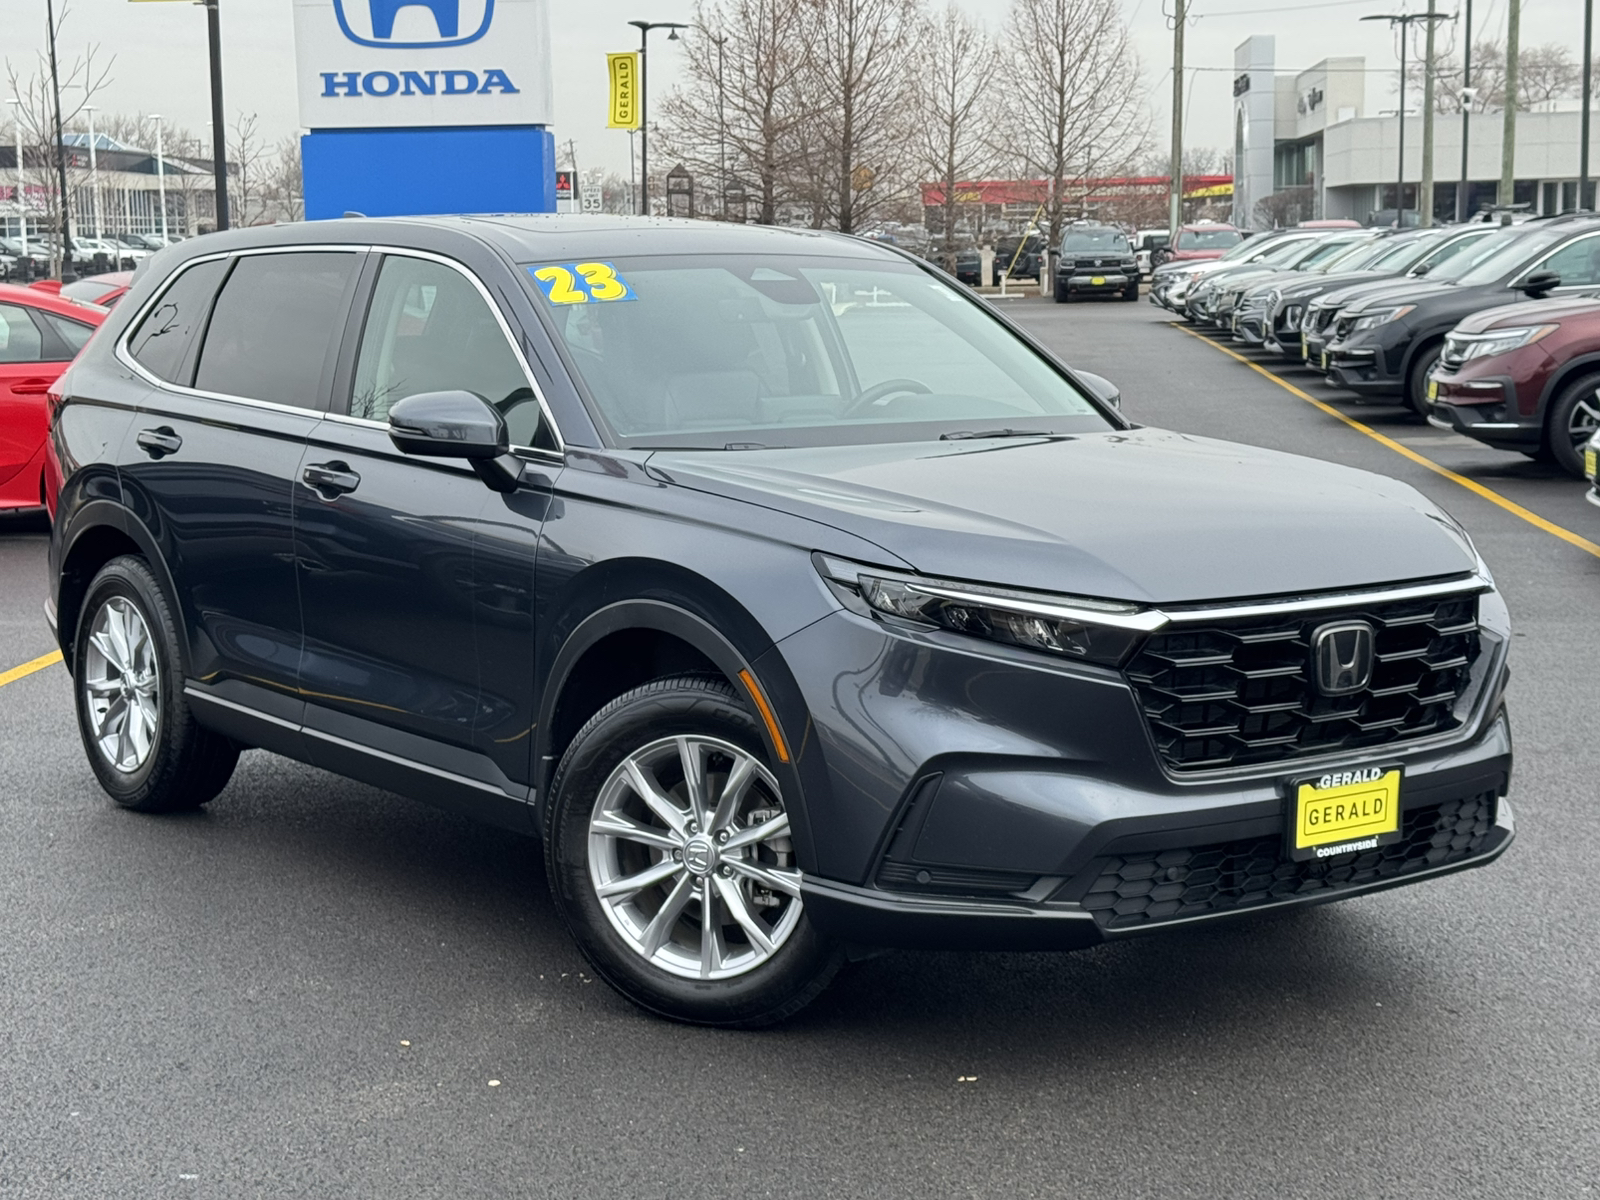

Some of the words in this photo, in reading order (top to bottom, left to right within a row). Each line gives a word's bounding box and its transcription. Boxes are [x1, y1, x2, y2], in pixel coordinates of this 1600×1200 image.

[319, 69, 520, 97] HONDA
[619, 62, 629, 118] GERALD
[584, 199, 601, 209] 35
[534, 262, 627, 304] 23
[1320, 768, 1381, 788] GERALD
[1309, 798, 1383, 826] GERALD
[1316, 839, 1378, 858] COUNTRYSIDE
